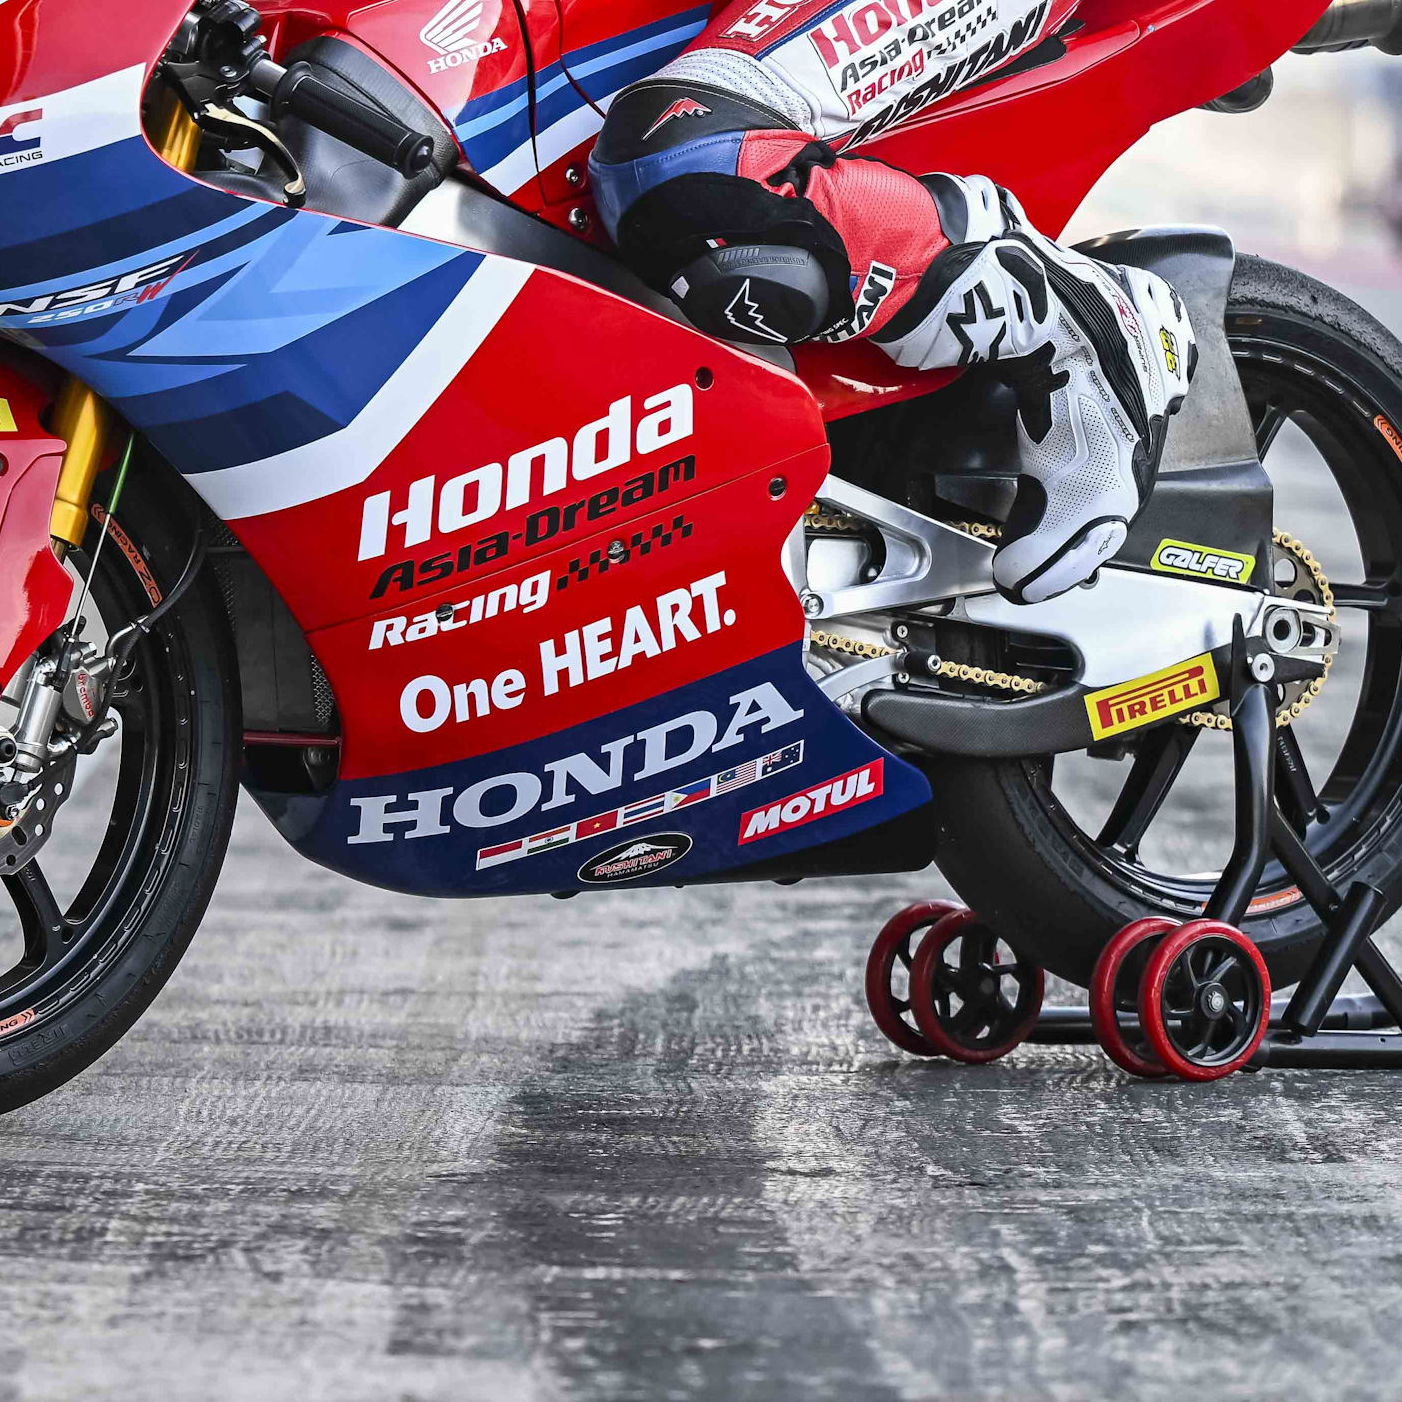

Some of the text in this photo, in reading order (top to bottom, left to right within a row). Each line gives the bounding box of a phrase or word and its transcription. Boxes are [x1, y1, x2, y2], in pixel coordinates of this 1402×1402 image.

[427, 37, 509, 75] HONDA
[847, 47, 925, 116] Racing
[833, 317, 849, 330] SPEC
[357, 383, 694, 562] Honda
[369, 454, 696, 600] Asia-Dream
[1159, 546, 1244, 580] GALFER
[368, 569, 552, 651] Racing
[400, 570, 737, 734] One HEART.
[77, 673, 95, 719] brembo
[1096, 665, 1208, 730] PIRELLI
[346, 681, 804, 845] HONDA
[743, 768, 876, 839] MOTUL
[594, 848, 673, 877] KUSHITANI
[606, 862, 659, 879] HAMAMATSU
